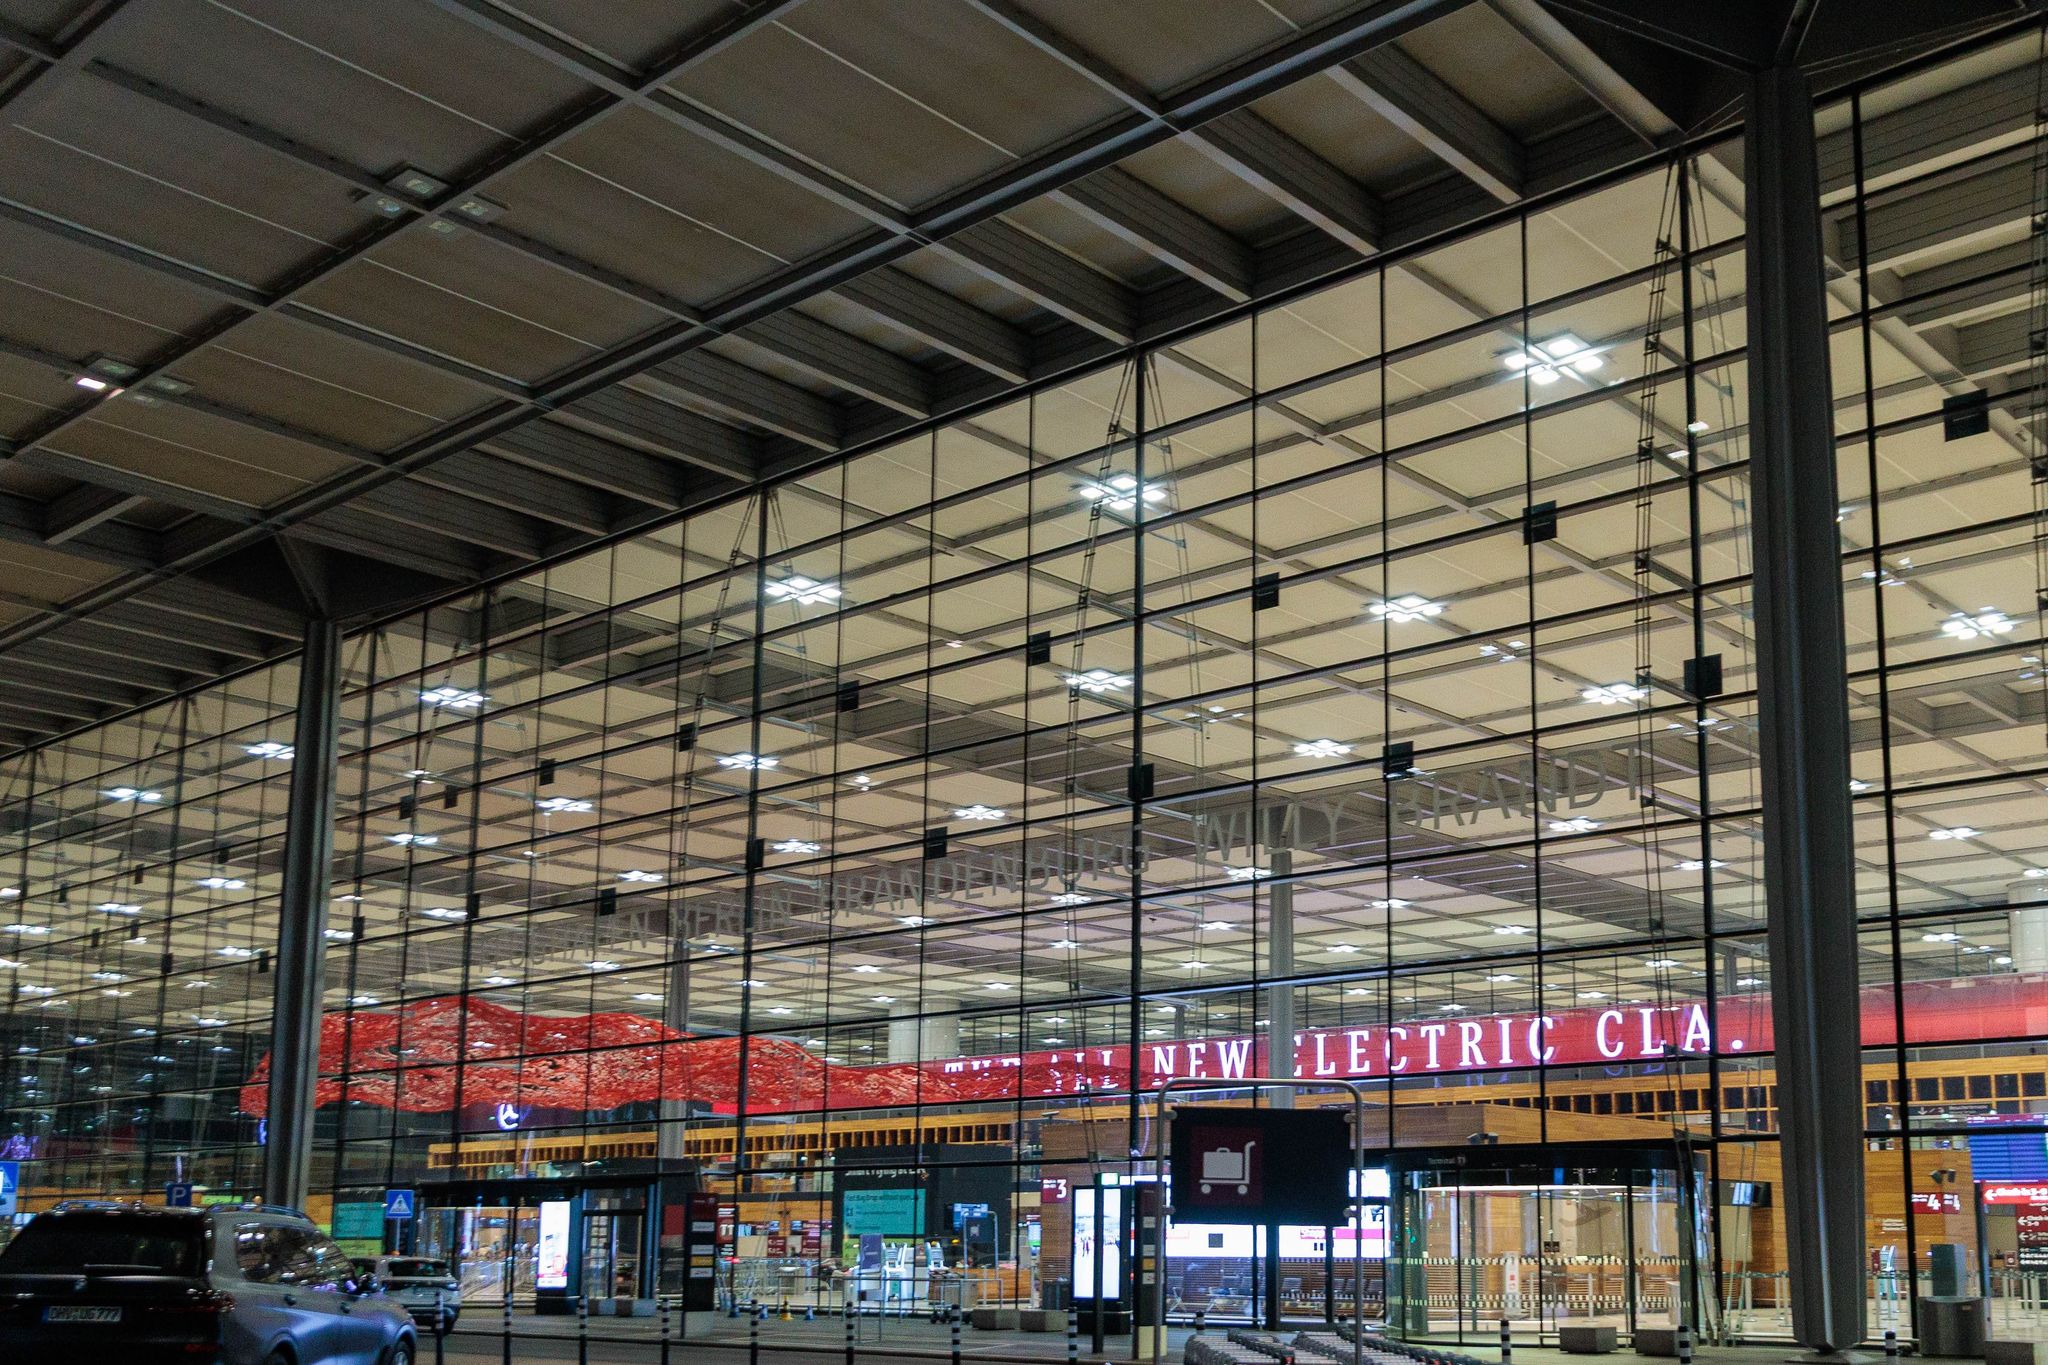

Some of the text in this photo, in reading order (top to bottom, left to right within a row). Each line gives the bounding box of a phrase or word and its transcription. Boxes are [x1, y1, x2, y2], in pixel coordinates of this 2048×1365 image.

[819, 825, 1150, 922] BRANDENBURG
[1192, 799, 1346, 862] WILLY
[1388, 742, 1649, 832] BRANDT
[1152, 1039, 1253, 1086] NEW
[172, 1186, 187, 1206] P
[1927, 1193, 1941, 1211] 4
